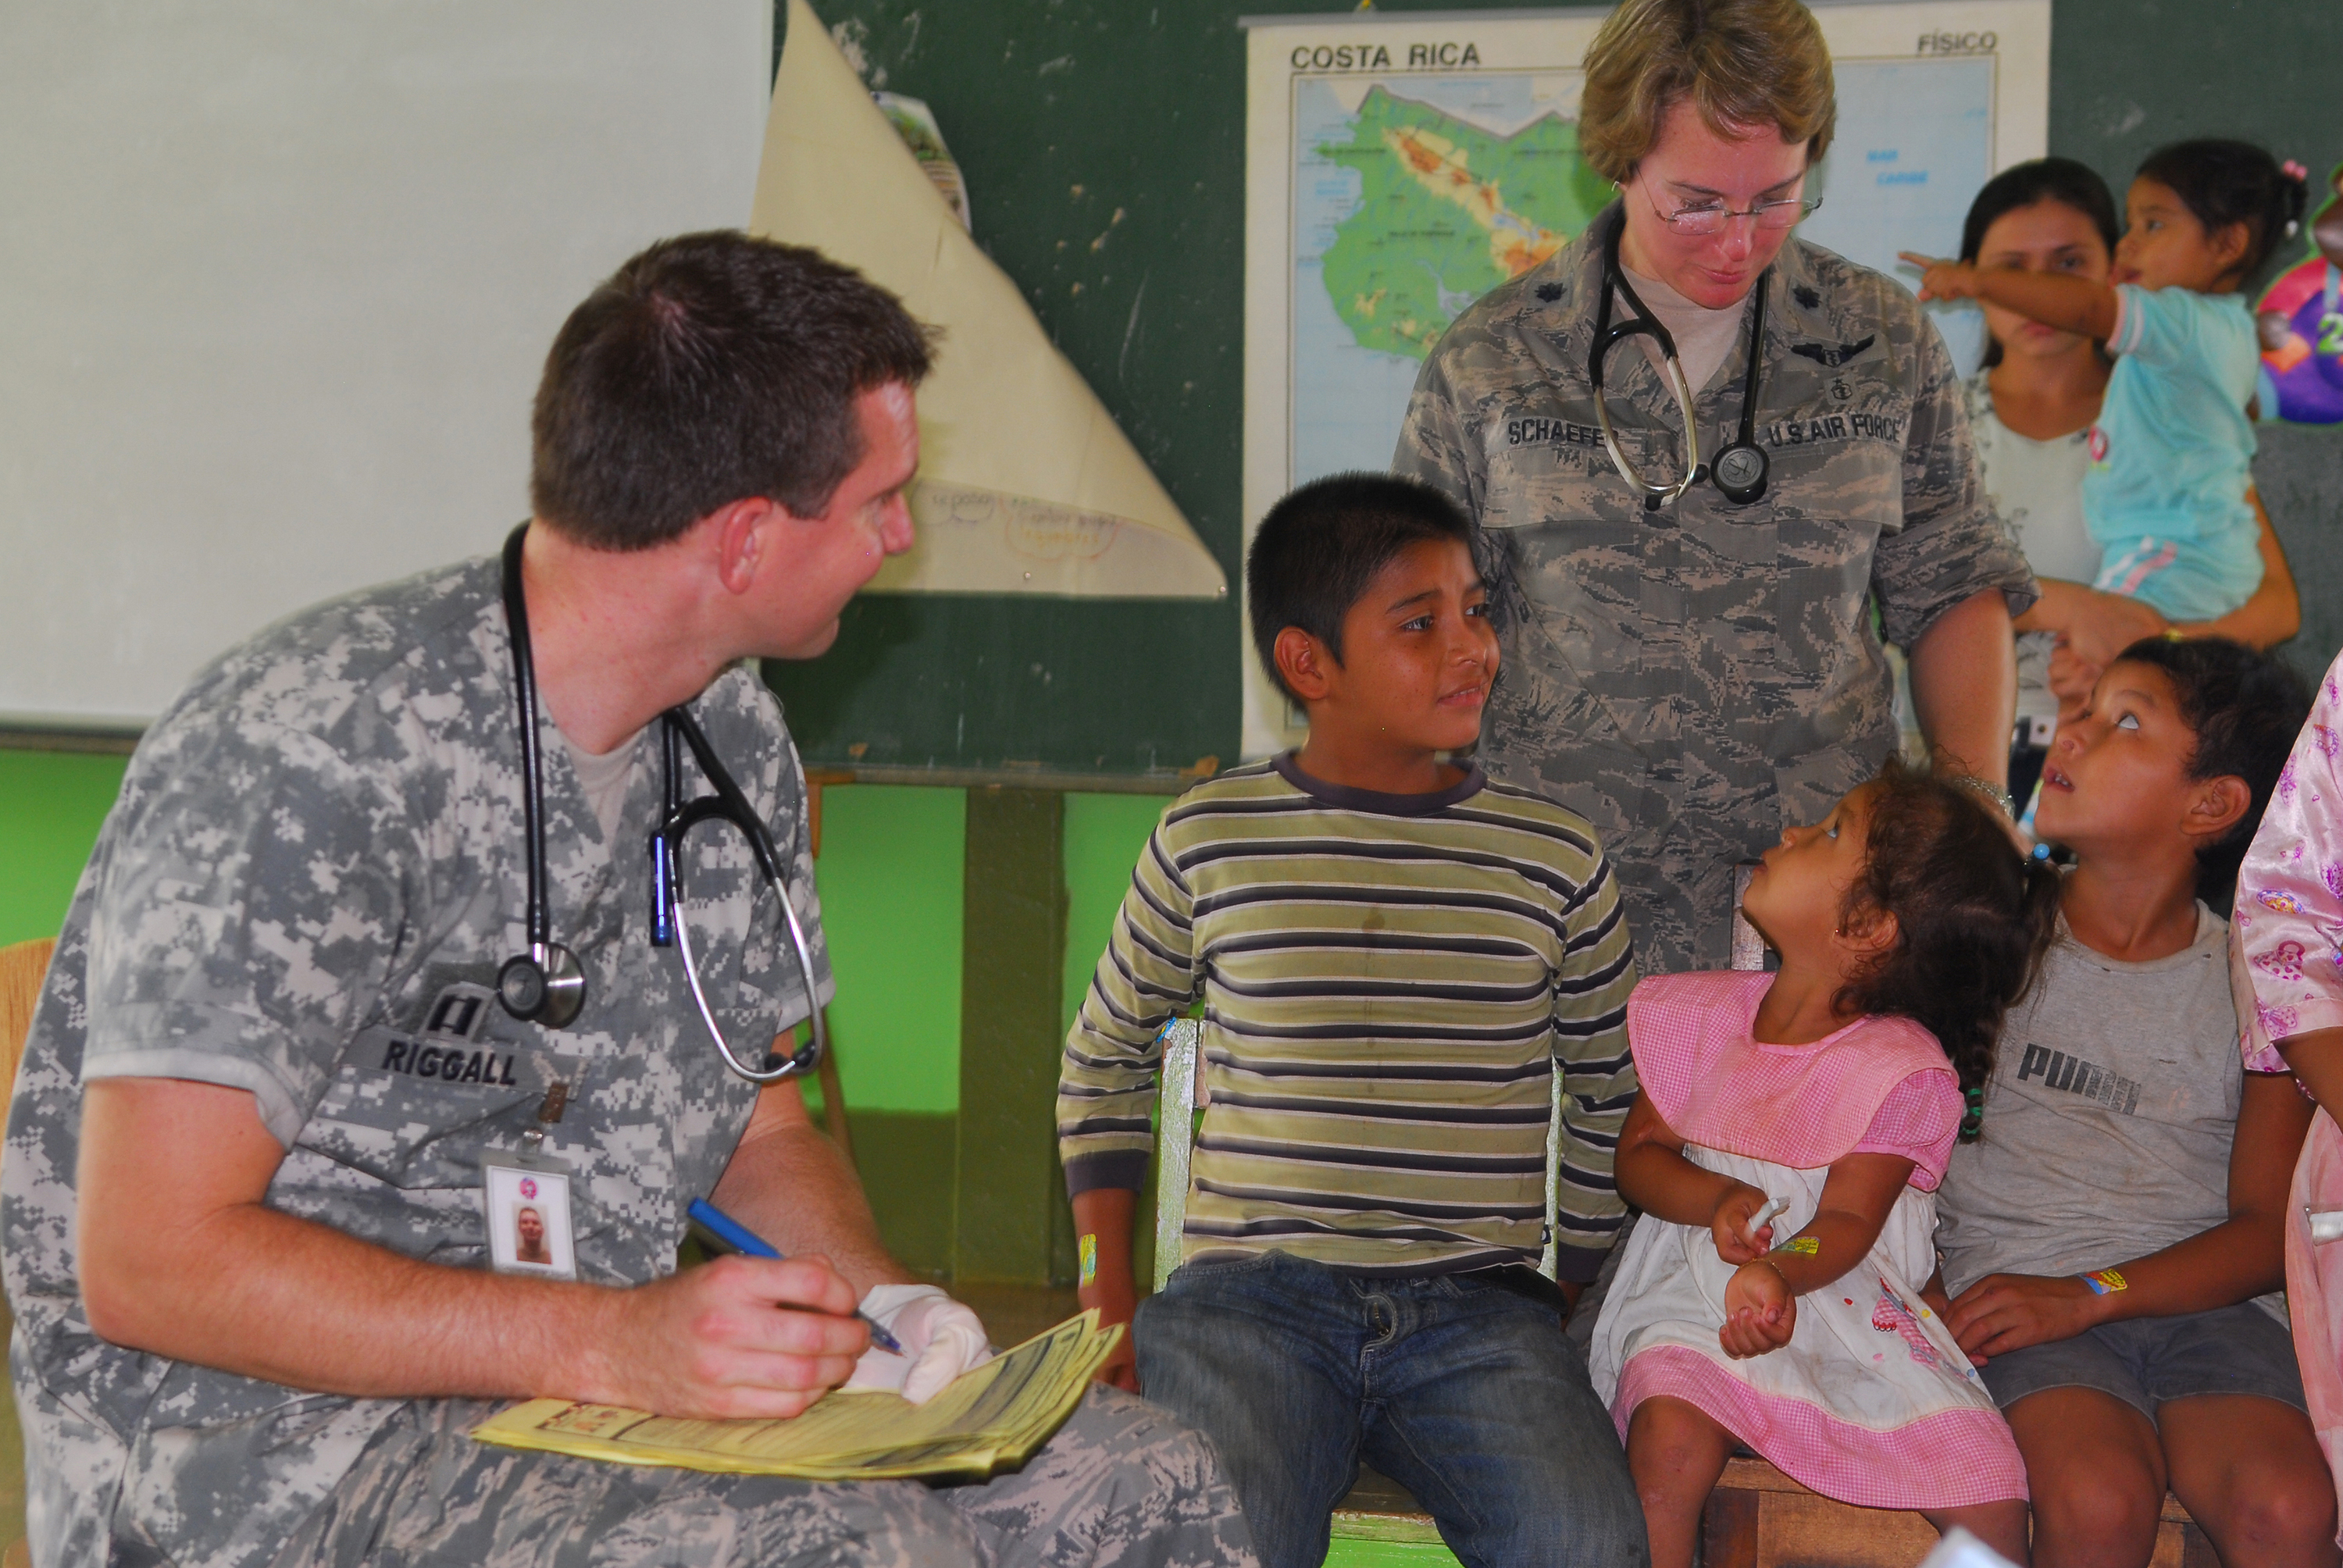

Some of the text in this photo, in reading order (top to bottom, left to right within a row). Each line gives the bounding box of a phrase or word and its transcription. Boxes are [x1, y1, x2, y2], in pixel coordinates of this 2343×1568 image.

[1917, 28, 1999, 52] FÍSICO
[1291, 42, 1481, 69] COSTA RICA
[1508, 419, 1619, 447] SCHAEFE
[1850, 412, 1902, 444] FORCE
[381, 1040, 516, 1085] RIGGALL
